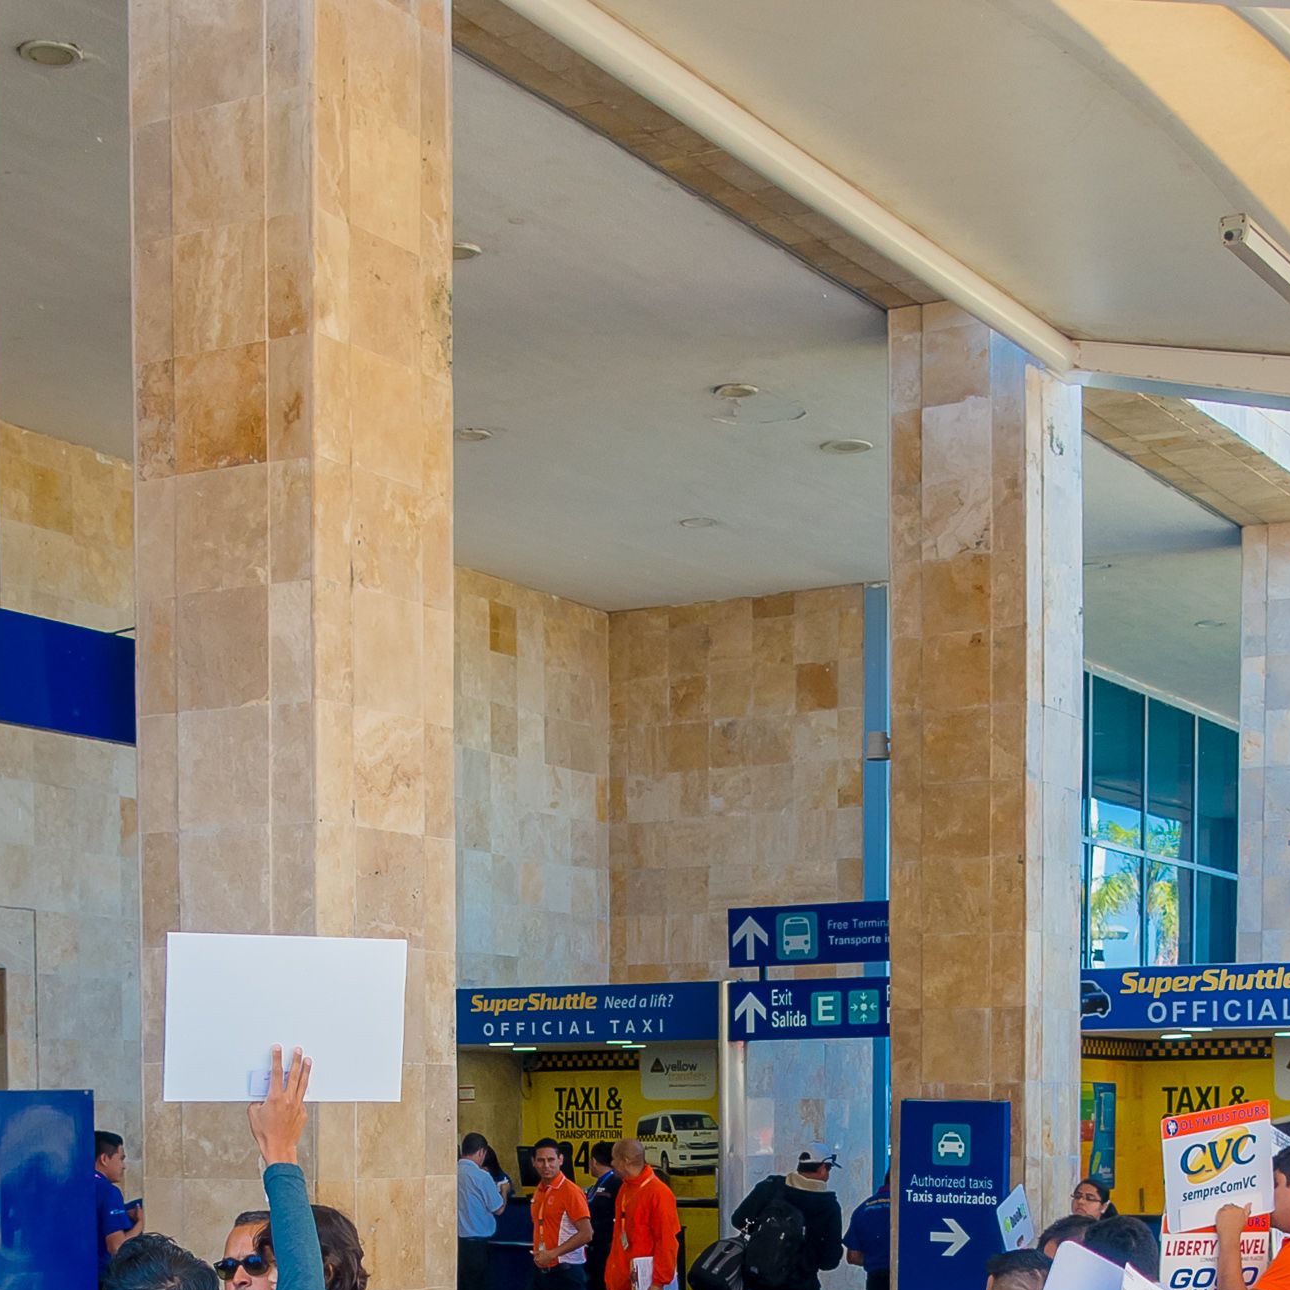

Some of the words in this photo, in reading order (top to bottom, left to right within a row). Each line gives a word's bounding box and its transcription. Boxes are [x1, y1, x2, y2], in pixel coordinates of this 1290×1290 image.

[827, 919, 849, 930] Free
[828, 935, 881, 946] Transporte
[470, 991, 597, 1016] SuperShuttle
[604, 995, 637, 1009] Need
[638, 997, 647, 1008] a
[649, 994, 674, 1008] lift?
[771, 988, 793, 1006] Exit
[817, 995, 836, 1021] E
[482, 1020, 596, 1036] OFFICIAL
[609, 1018, 665, 1034] TAXI
[771, 1010, 807, 1028] Salida
[665, 1060, 698, 1075] yellow
[554, 1087, 600, 1111] TAXI
[606, 1087, 623, 1111] &
[1162, 1086, 1223, 1113] TAXI
[1230, 1086, 1249, 1104] &
[554, 1111, 623, 1129] SHUTTLE
[1180, 1112, 1231, 1131] OLYMPUS
[1232, 1105, 1268, 1119] TOURS
[556, 1130, 623, 1140] TRANSPORTATION
[1180, 1134, 1257, 1175] CVC
[910, 1174, 966, 1188] Authorized
[969, 1177, 993, 1190] taxis
[906, 1189, 933, 1203] Taxis
[936, 1192, 997, 1205] autorizados
[1165, 1239, 1218, 1257] LIBERTY
[1240, 1238, 1266, 1255] AVEL
